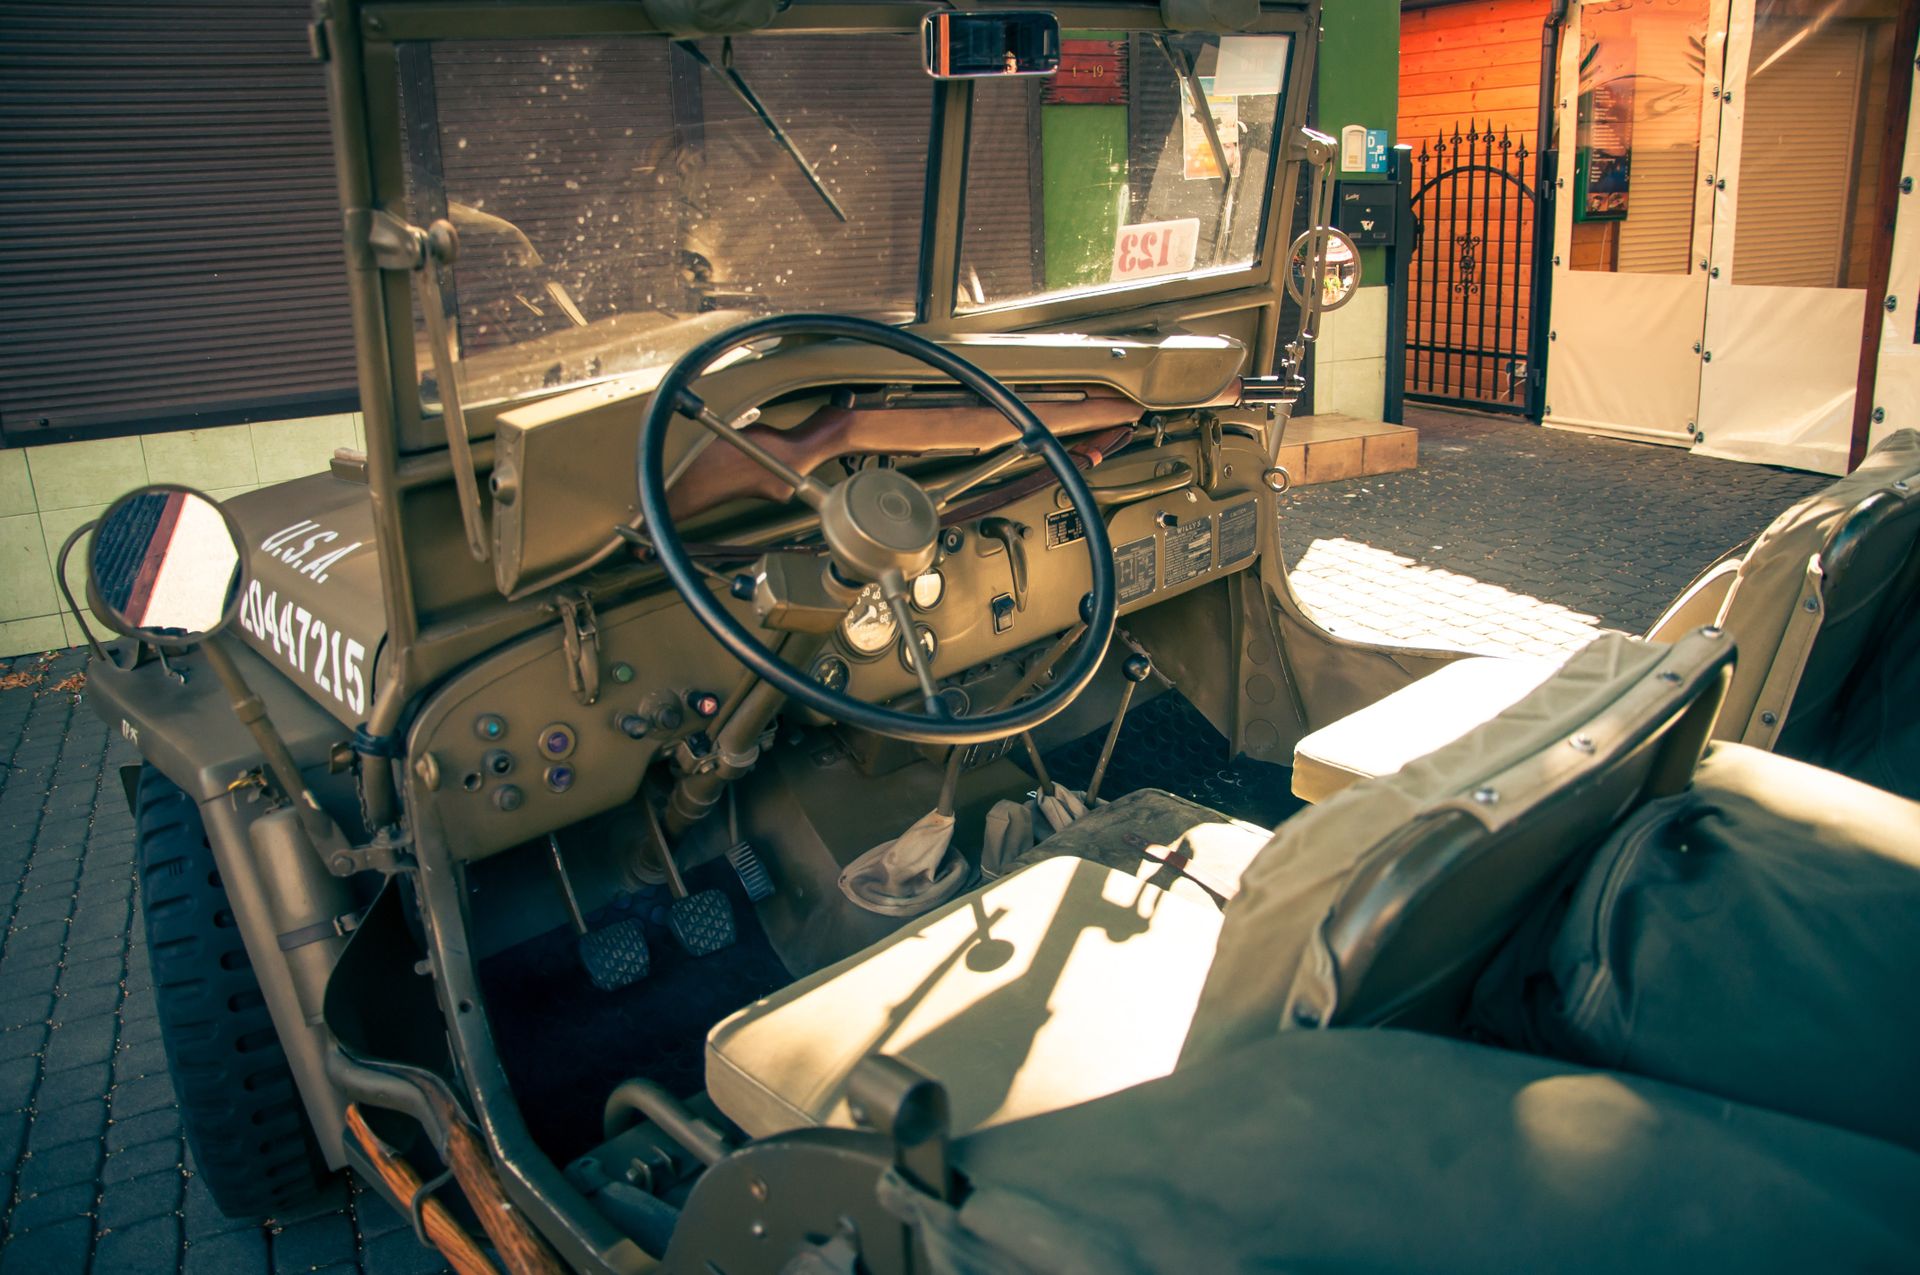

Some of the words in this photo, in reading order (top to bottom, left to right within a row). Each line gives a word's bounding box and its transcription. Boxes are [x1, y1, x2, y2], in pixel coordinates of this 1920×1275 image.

[1093, 64, 1104, 78] 19
[1367, 135, 1375, 148] D
[261, 519, 362, 584] U.S.A.
[872, 591, 880, 600] 40
[879, 601, 887, 611] 50
[880, 613, 889, 624] 60
